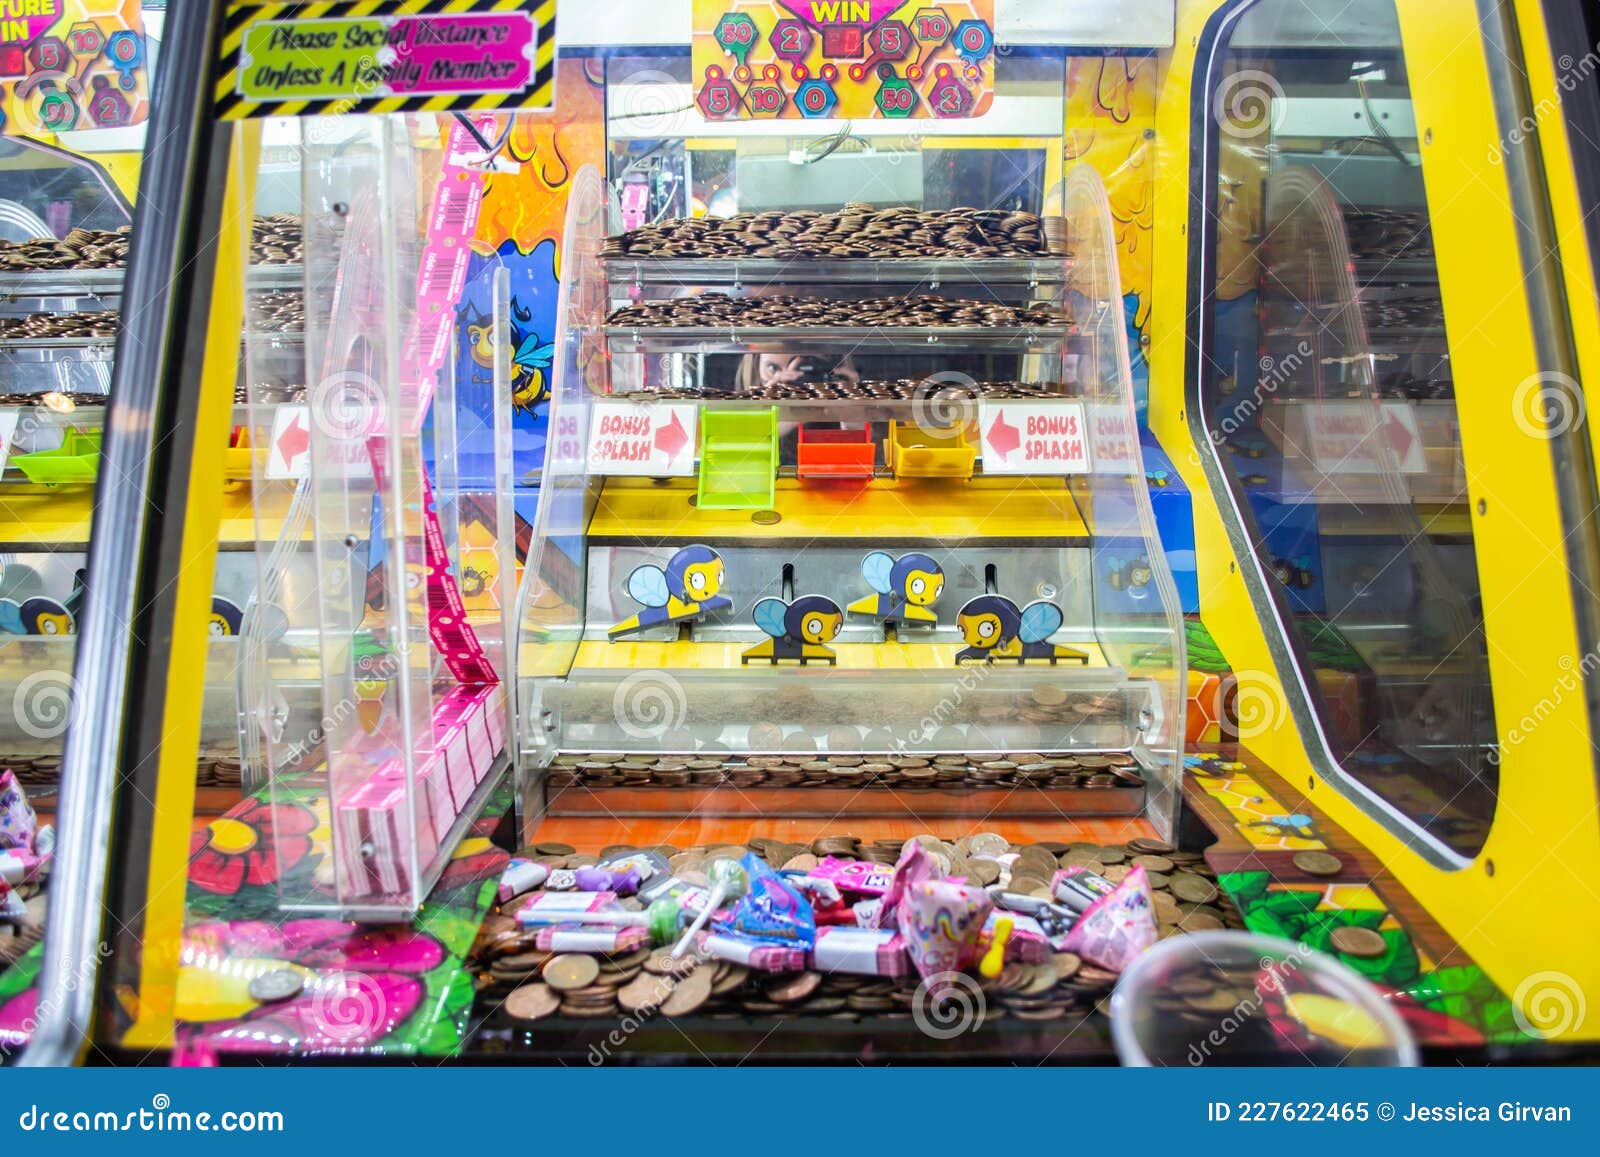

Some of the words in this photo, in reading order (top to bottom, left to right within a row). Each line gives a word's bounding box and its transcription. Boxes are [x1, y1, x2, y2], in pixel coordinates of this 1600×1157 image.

[811, 0, 870, 23] WIN
[70, 28, 101, 54] 10
[268, 25, 338, 51] Please
[342, 20, 411, 49] Social
[413, 19, 510, 47] Distance
[722, 21, 754, 45] 50
[780, 26, 802, 53] 2
[879, 26, 901, 53] 5
[917, 15, 949, 41] 10
[961, 26, 985, 52] 0
[40, 42, 60, 70] 5
[114, 37, 137, 62] 0
[254, 60, 324, 90] Unless
[328, 60, 347, 87] A
[351, 56, 423, 89] Family
[427, 53, 517, 81] Member
[99, 95, 120, 122] 2
[708, 87, 731, 113] 5
[750, 86, 783, 113] 10
[804, 86, 827, 112] 0
[881, 87, 914, 111] 50
[939, 85, 962, 113] 2
[600, 415, 651, 436] BONUS
[1026, 415, 1078, 436] BONUS
[593, 439, 652, 461] SPLASH
[1024, 440, 1084, 461] SPLASH
